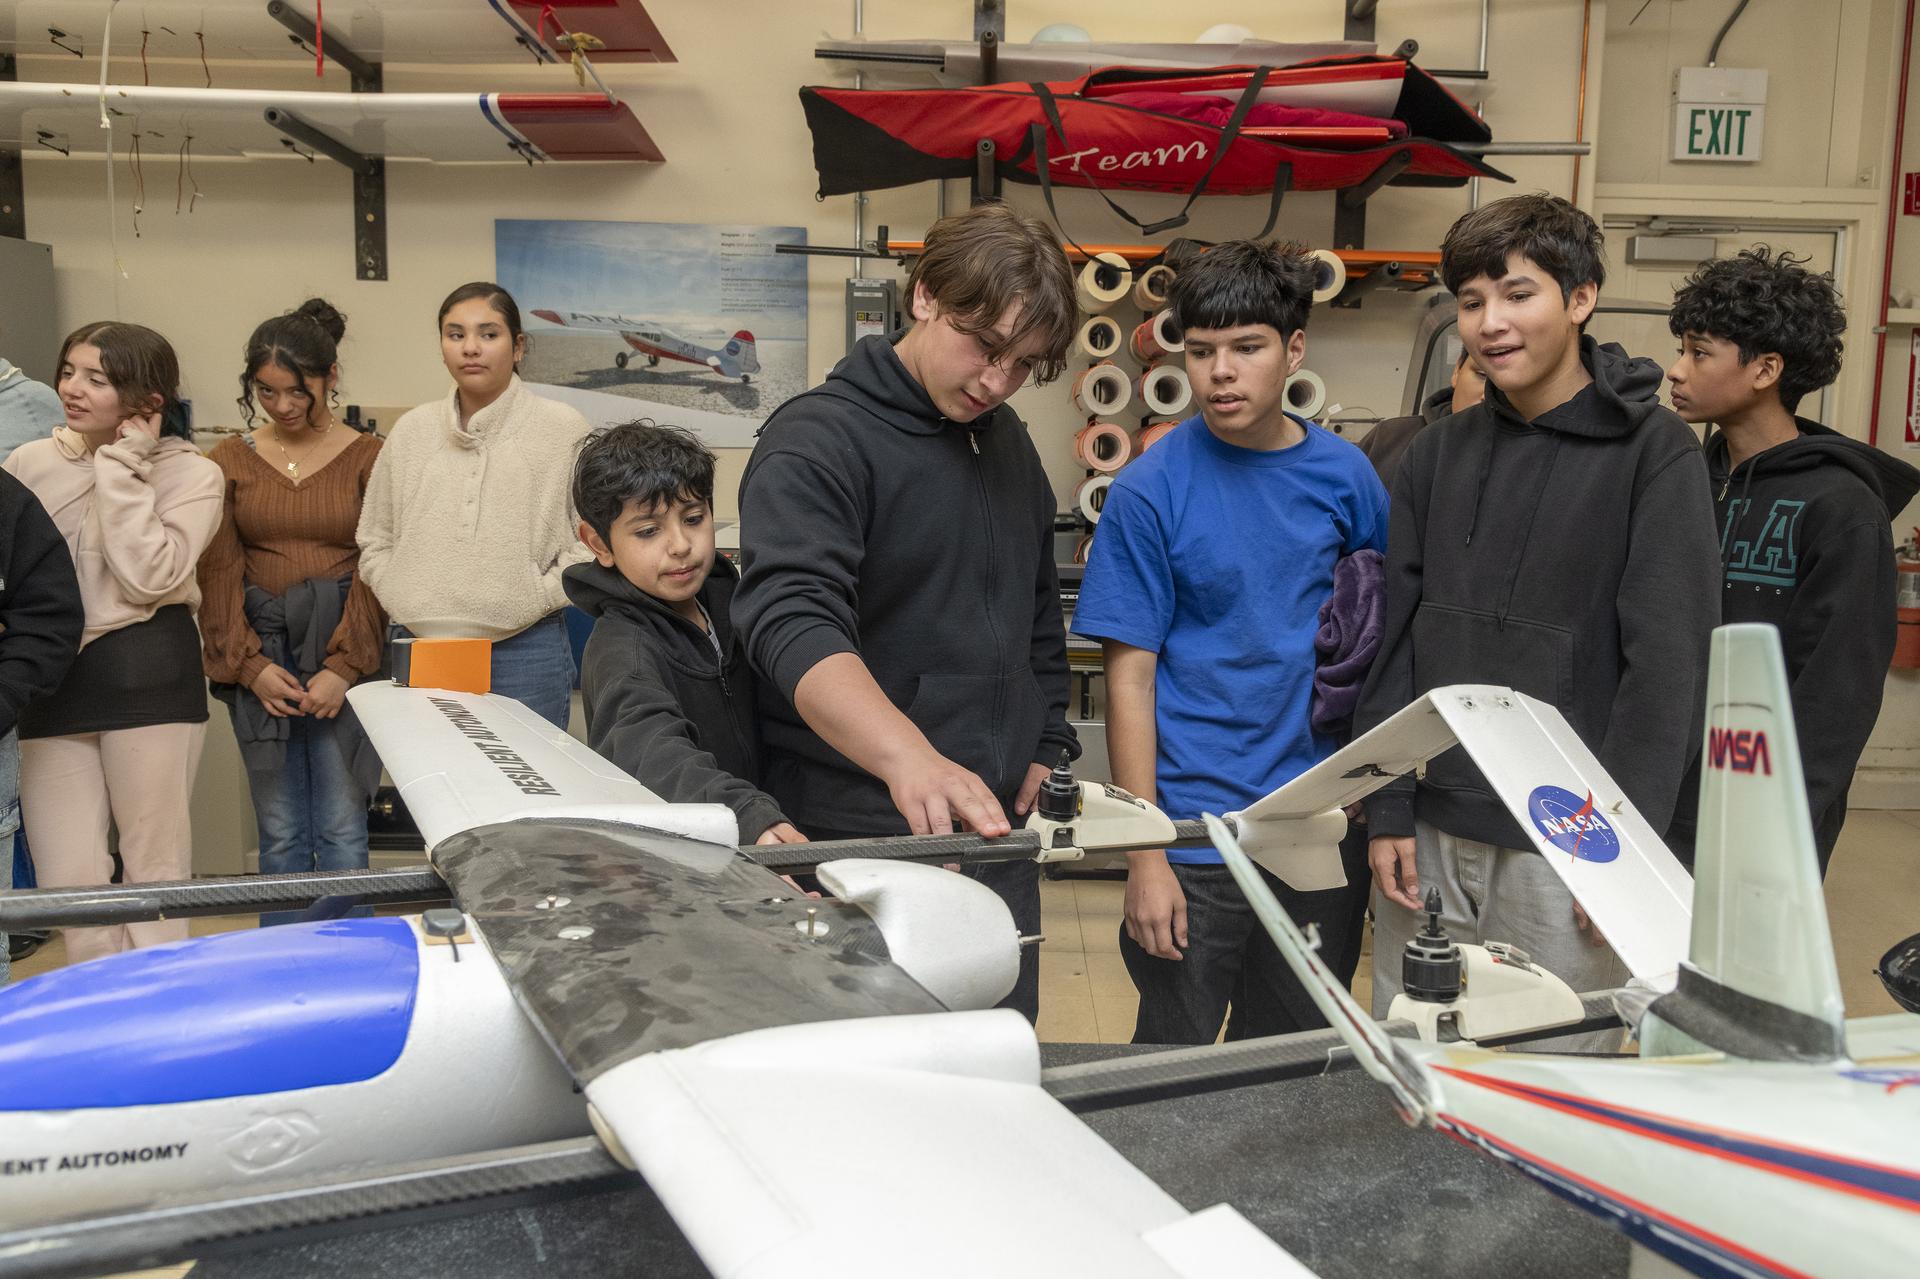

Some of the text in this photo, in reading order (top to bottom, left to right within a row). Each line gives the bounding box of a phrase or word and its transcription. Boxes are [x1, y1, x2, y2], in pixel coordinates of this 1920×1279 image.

[1049, 140, 1208, 172] Team
[1688, 109, 1752, 156] EXIT
[1720, 498, 1806, 574] LA
[426, 696, 562, 796] RESILIENT AUTONOMY
[1708, 726, 1773, 777] NASA
[1541, 814, 1610, 837] NASA
[57, 1142, 189, 1172] AUTONOMY
